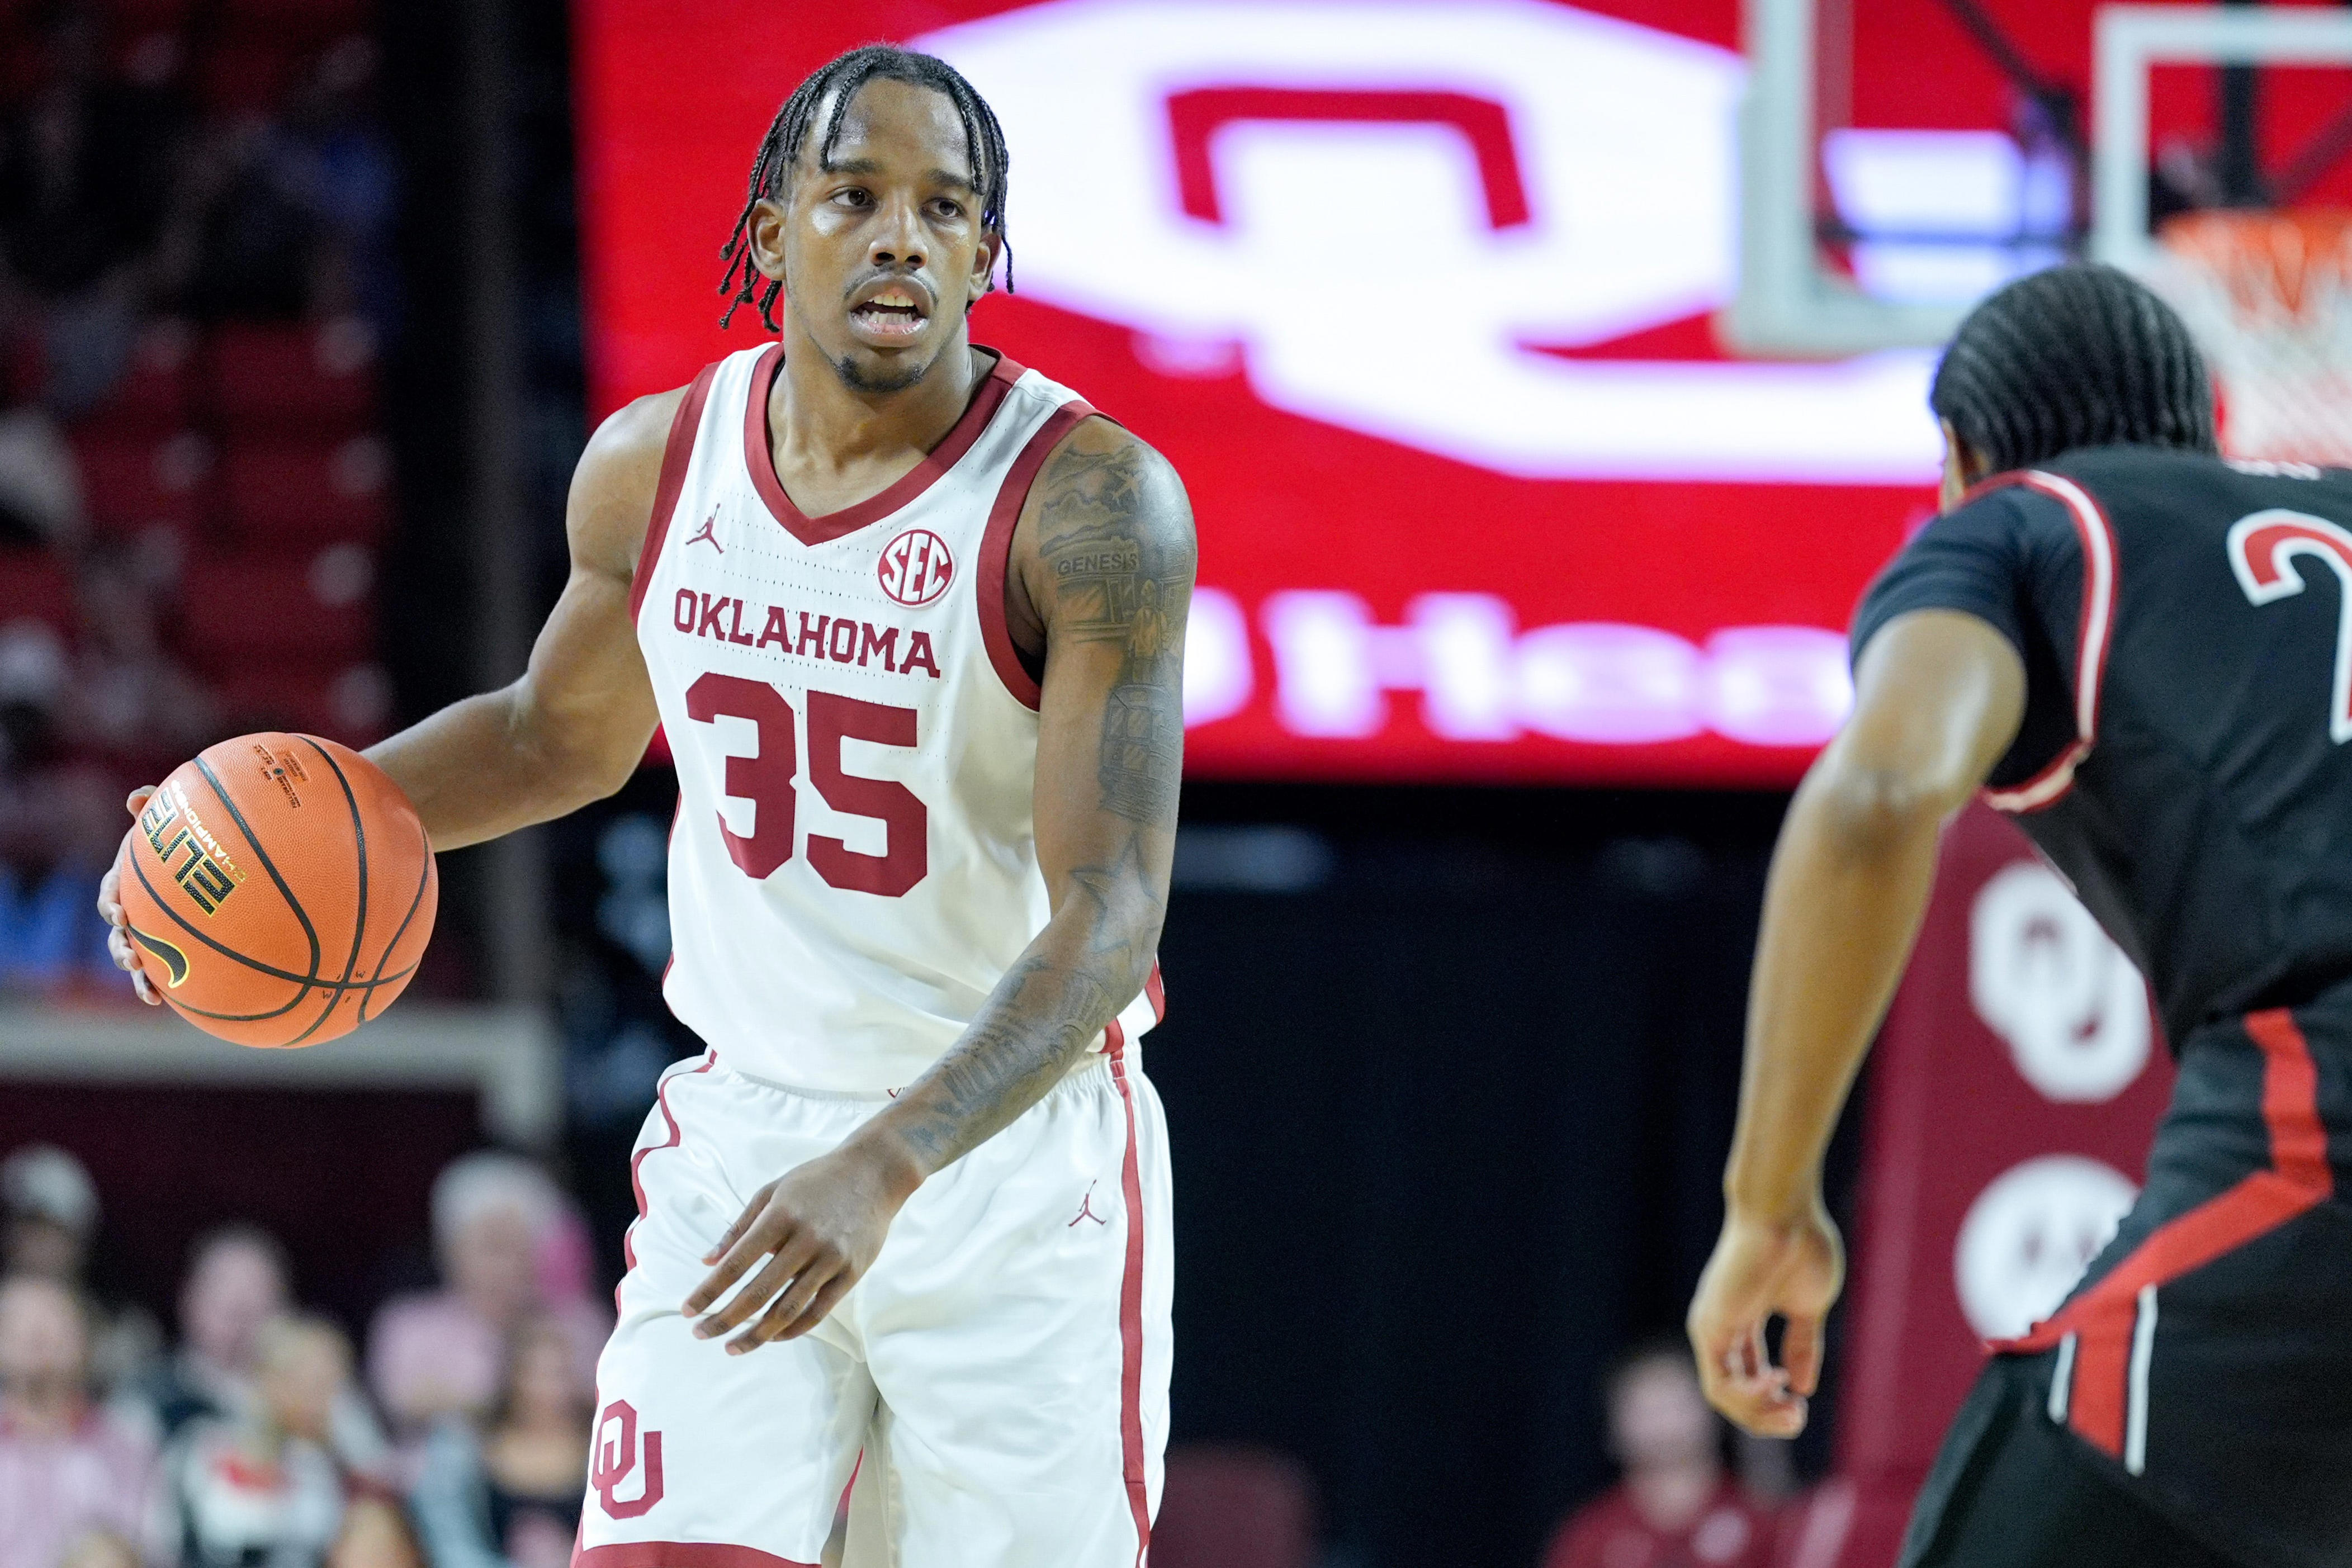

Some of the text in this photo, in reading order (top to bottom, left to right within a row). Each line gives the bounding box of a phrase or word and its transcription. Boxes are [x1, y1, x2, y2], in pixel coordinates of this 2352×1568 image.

[881, 532, 949, 603] SEC
[1057, 552, 1137, 575] GENESIS
[675, 589, 940, 678] OKLAHOMA
[687, 672, 927, 897] 35
[141, 787, 237, 918] ELITE
[591, 1399, 664, 1520] OU
